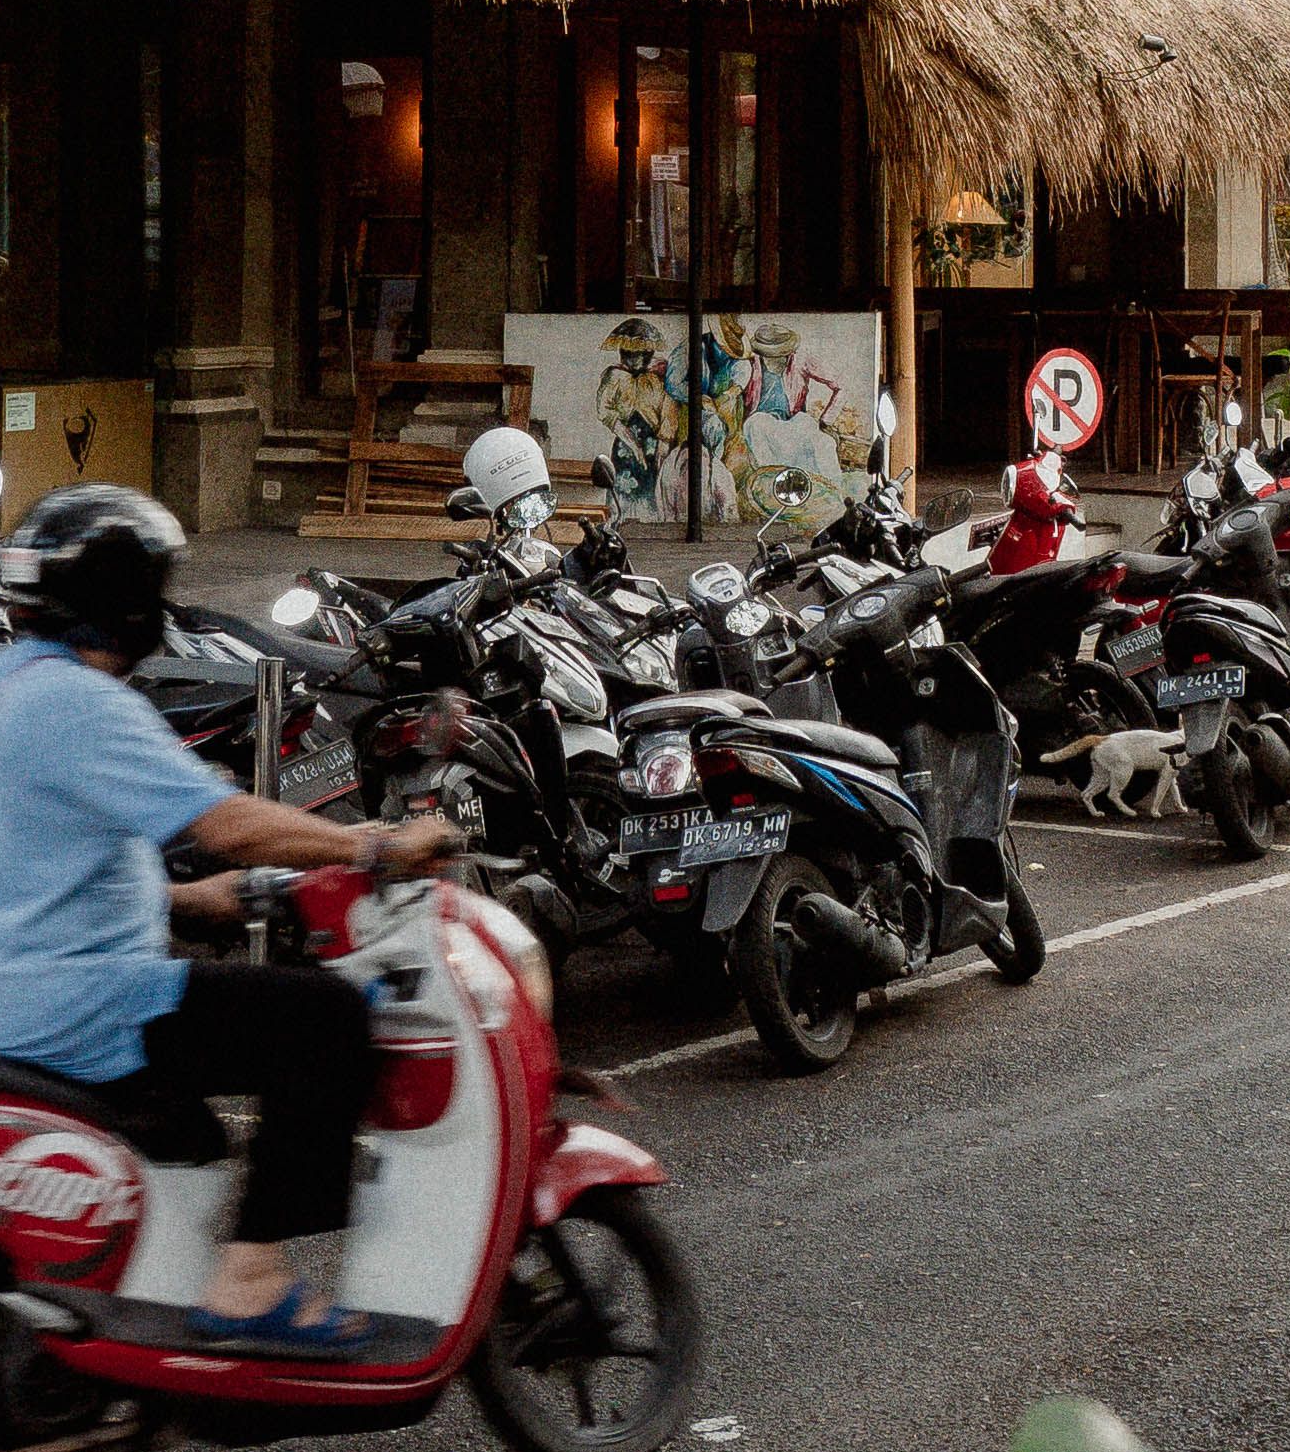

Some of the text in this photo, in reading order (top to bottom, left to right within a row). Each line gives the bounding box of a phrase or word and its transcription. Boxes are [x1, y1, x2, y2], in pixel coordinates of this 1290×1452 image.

[1161, 669, 1242, 693] DK 2441 LJ
[457, 799, 480, 820] ME
[624, 818, 644, 836] DK
[683, 815, 785, 847] DK 6719 MN
